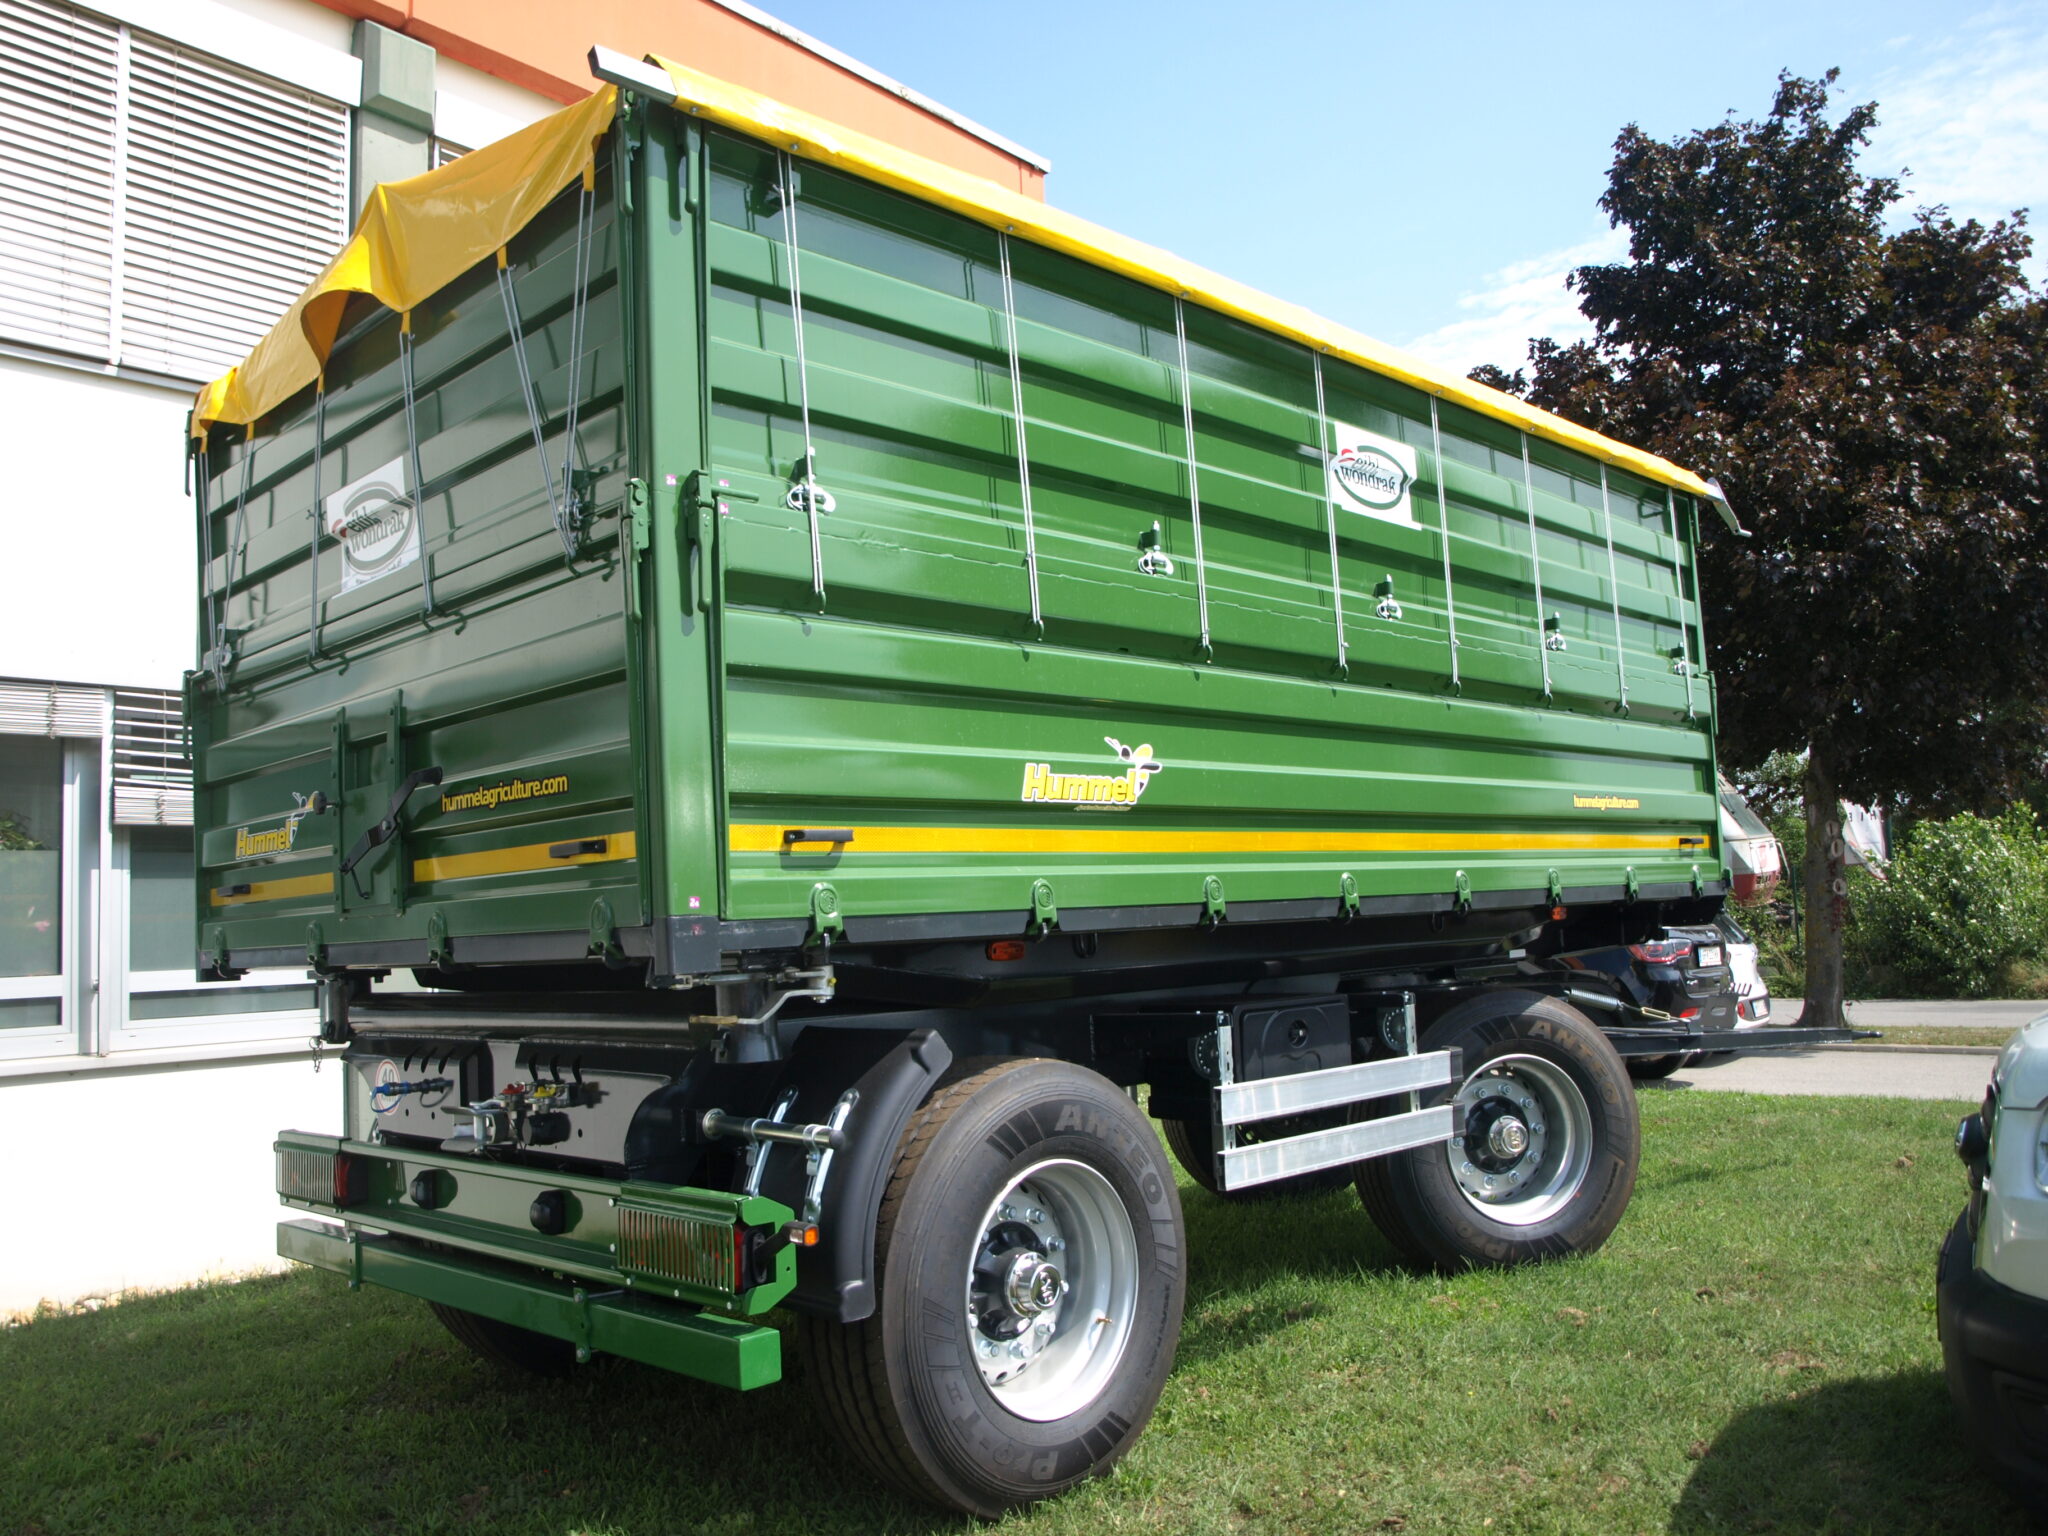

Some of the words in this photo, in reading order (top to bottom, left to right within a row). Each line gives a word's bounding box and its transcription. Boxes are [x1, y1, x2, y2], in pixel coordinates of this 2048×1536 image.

[442, 776, 568, 813] hummelagriculture.com
[1023, 763, 1137, 804] Hummel
[236, 819, 292, 860] Hummel
[1054, 1104, 1163, 1205] ANTEO
